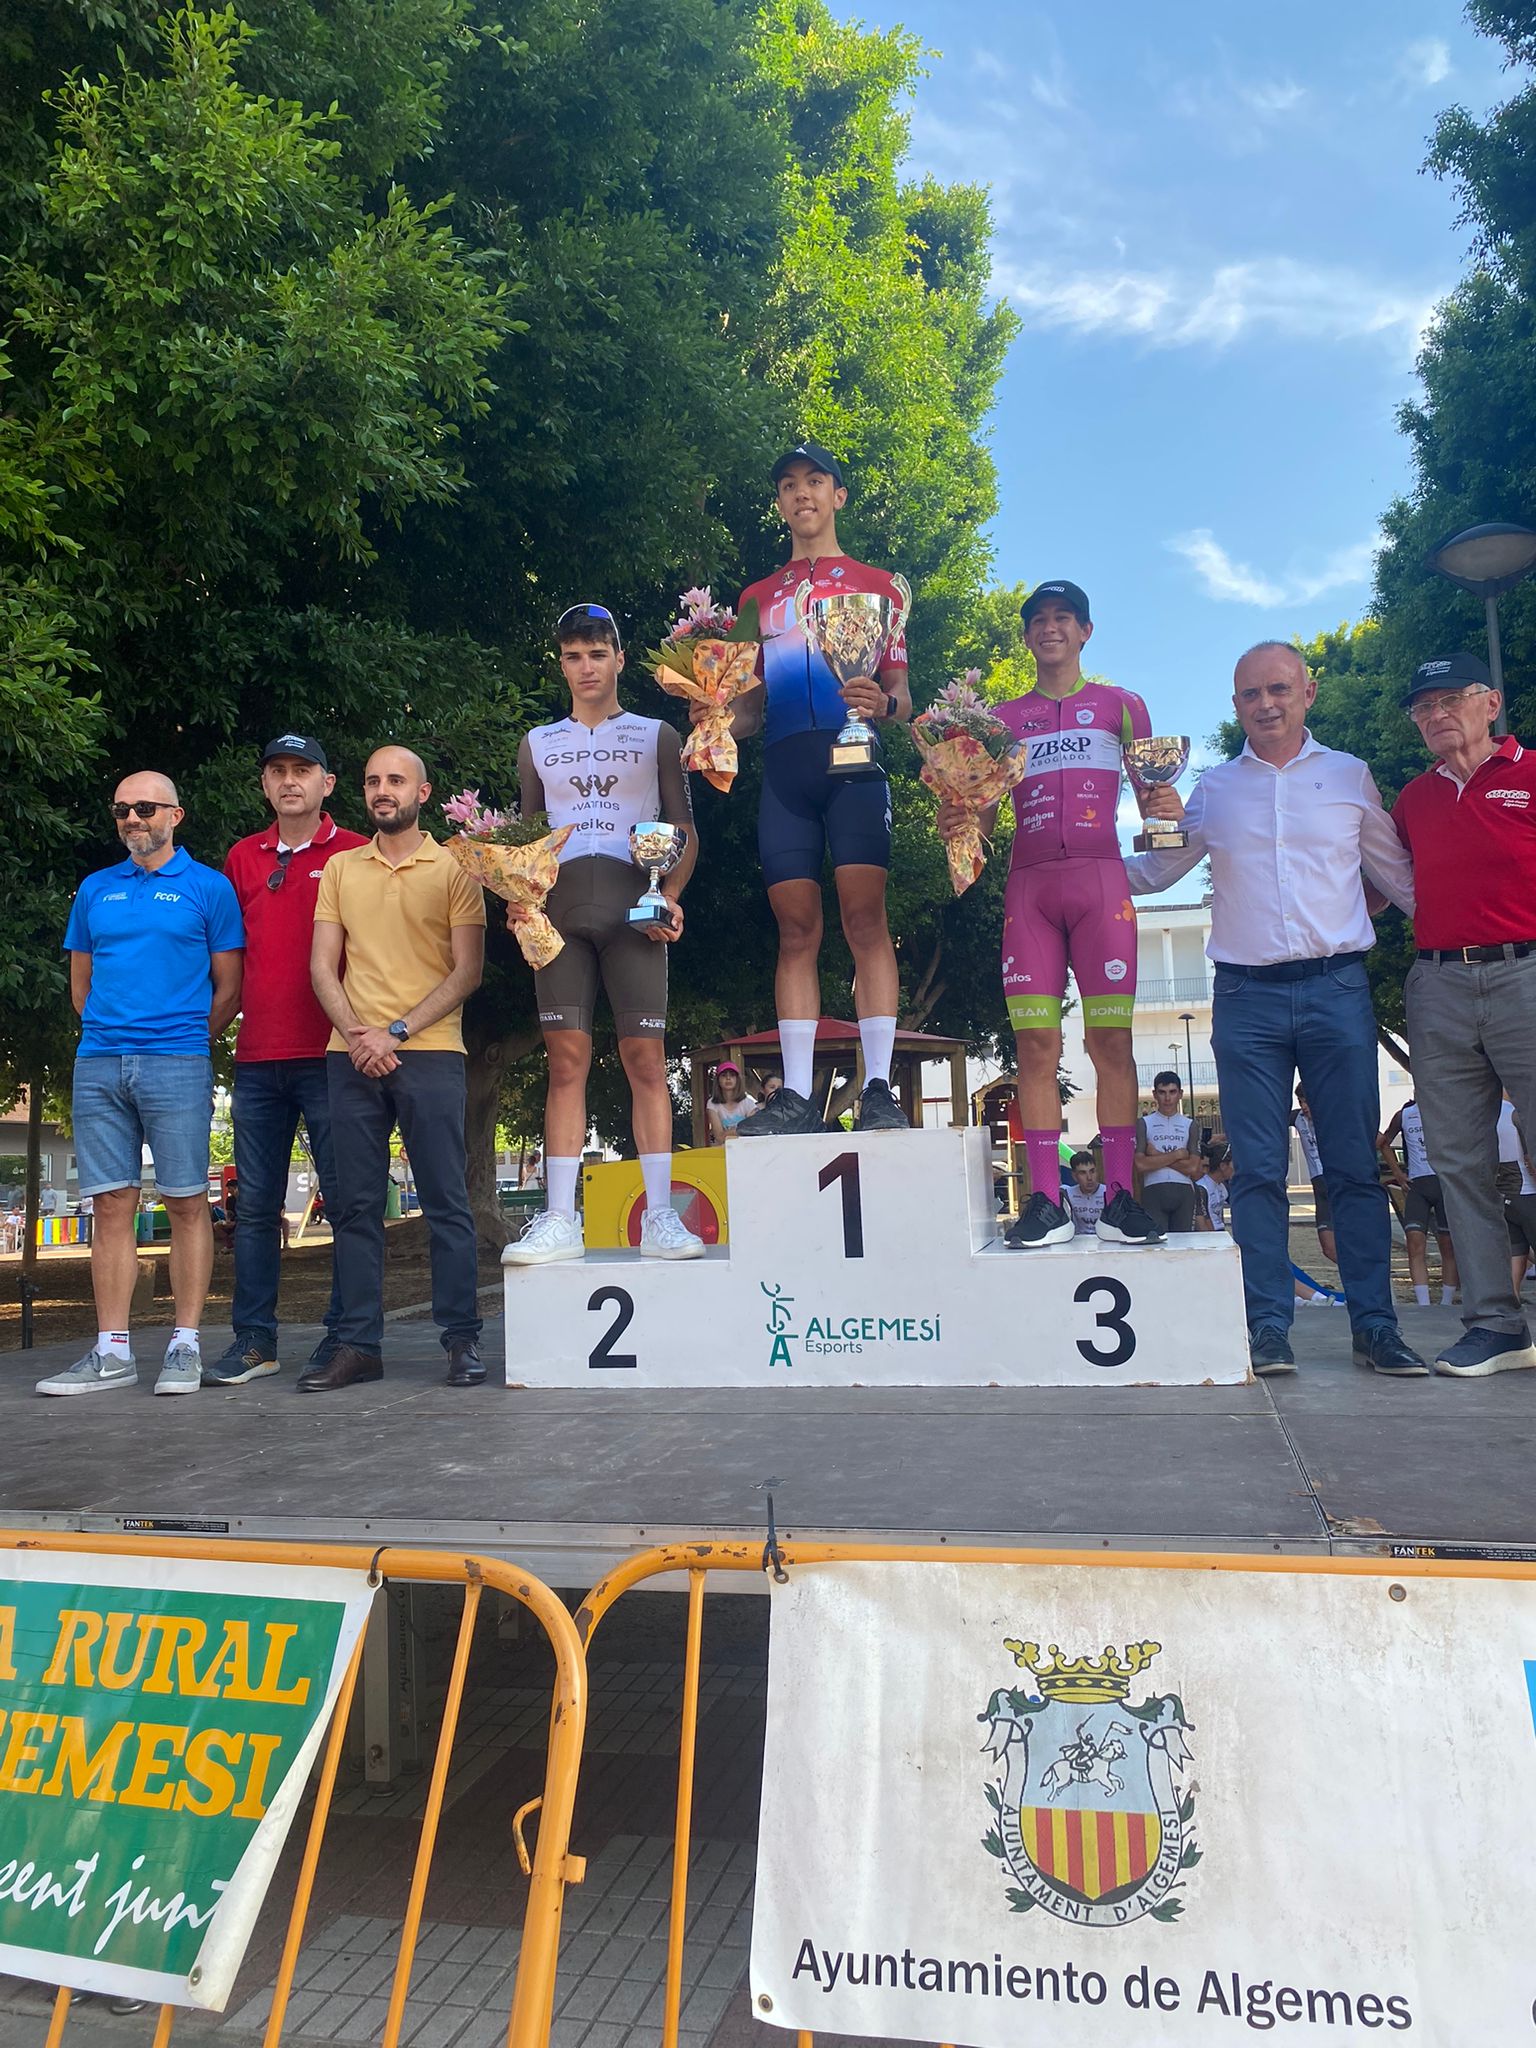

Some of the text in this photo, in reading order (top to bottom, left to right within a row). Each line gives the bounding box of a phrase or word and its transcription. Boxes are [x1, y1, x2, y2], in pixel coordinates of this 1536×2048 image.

[544, 749, 644, 768] GSPORT
[1030, 753, 1092, 769] ABOGADOS
[1031, 736, 1091, 760] ZB&P
[153, 891, 181, 903] FCCV
[1010, 1007, 1049, 1018] TEAM
[818, 1152, 864, 1258] 1
[587, 1285, 637, 1368] 2
[805, 1314, 941, 1342] ALGEMESÍ
[1073, 1276, 1137, 1367] 3
[805, 1339, 863, 1355] Esports
[126, 1520, 154, 1529] FANTEK
[1394, 1546, 1435, 1556] FANTEK
[42, 1610, 311, 1705] RURAL
[0, 1709, 282, 1820] EMESI
[1003, 1803, 1180, 1922] AJUNTAMENT D'ALGEMESI
[792, 1938, 1412, 2030] Ayuntamiento de Algemes
